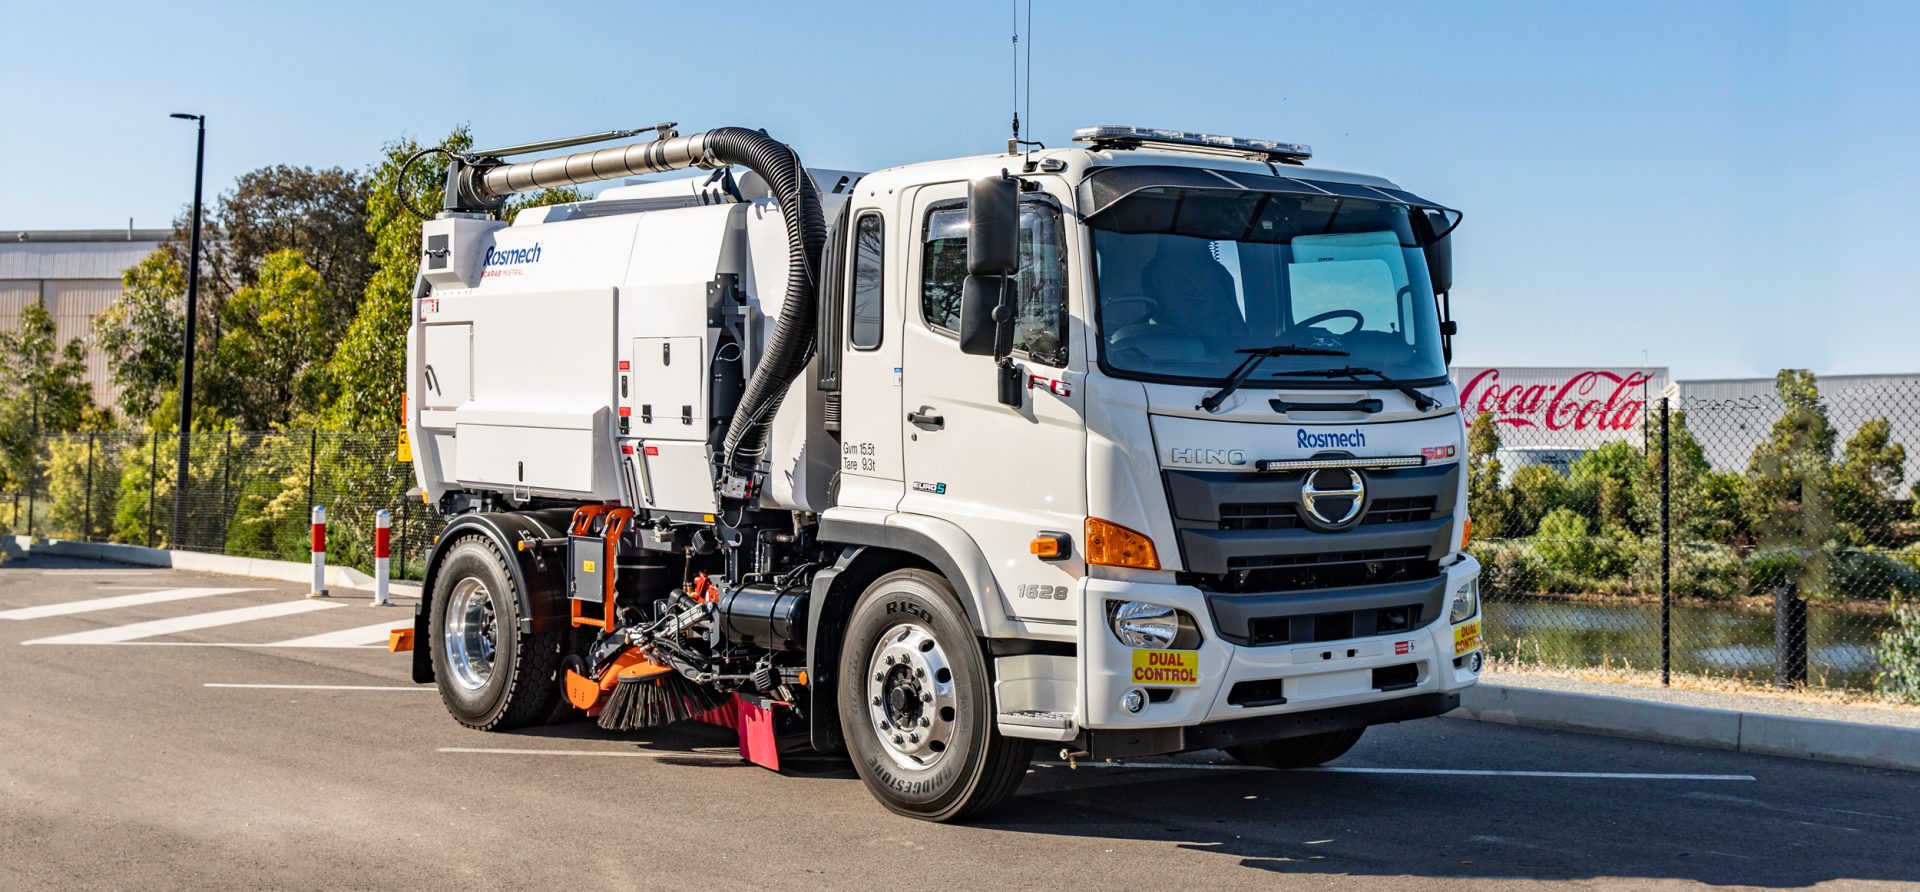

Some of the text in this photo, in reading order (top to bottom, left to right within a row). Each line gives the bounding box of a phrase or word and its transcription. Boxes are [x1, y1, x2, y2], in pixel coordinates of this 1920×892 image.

[483, 242, 541, 267] Rosmech
[1028, 374, 1071, 397] FG
[1459, 368, 1656, 431] Coca-Cola
[1297, 428, 1365, 448] Rosmech
[843, 441, 875, 456] Gvm 15.5t
[1171, 447, 1247, 466] HINO
[1421, 444, 1456, 460] 500
[843, 457, 875, 471] Tare 9.3t
[1017, 584, 1069, 600] 1628
[886, 601, 933, 624] R150
[1461, 623, 1477, 637] DUAL
[1455, 633, 1482, 653] CONTR
[1149, 652, 1184, 666] DUAL
[1134, 667, 1197, 682] CONTROL
[867, 756, 953, 794] BRIDGESTONE
